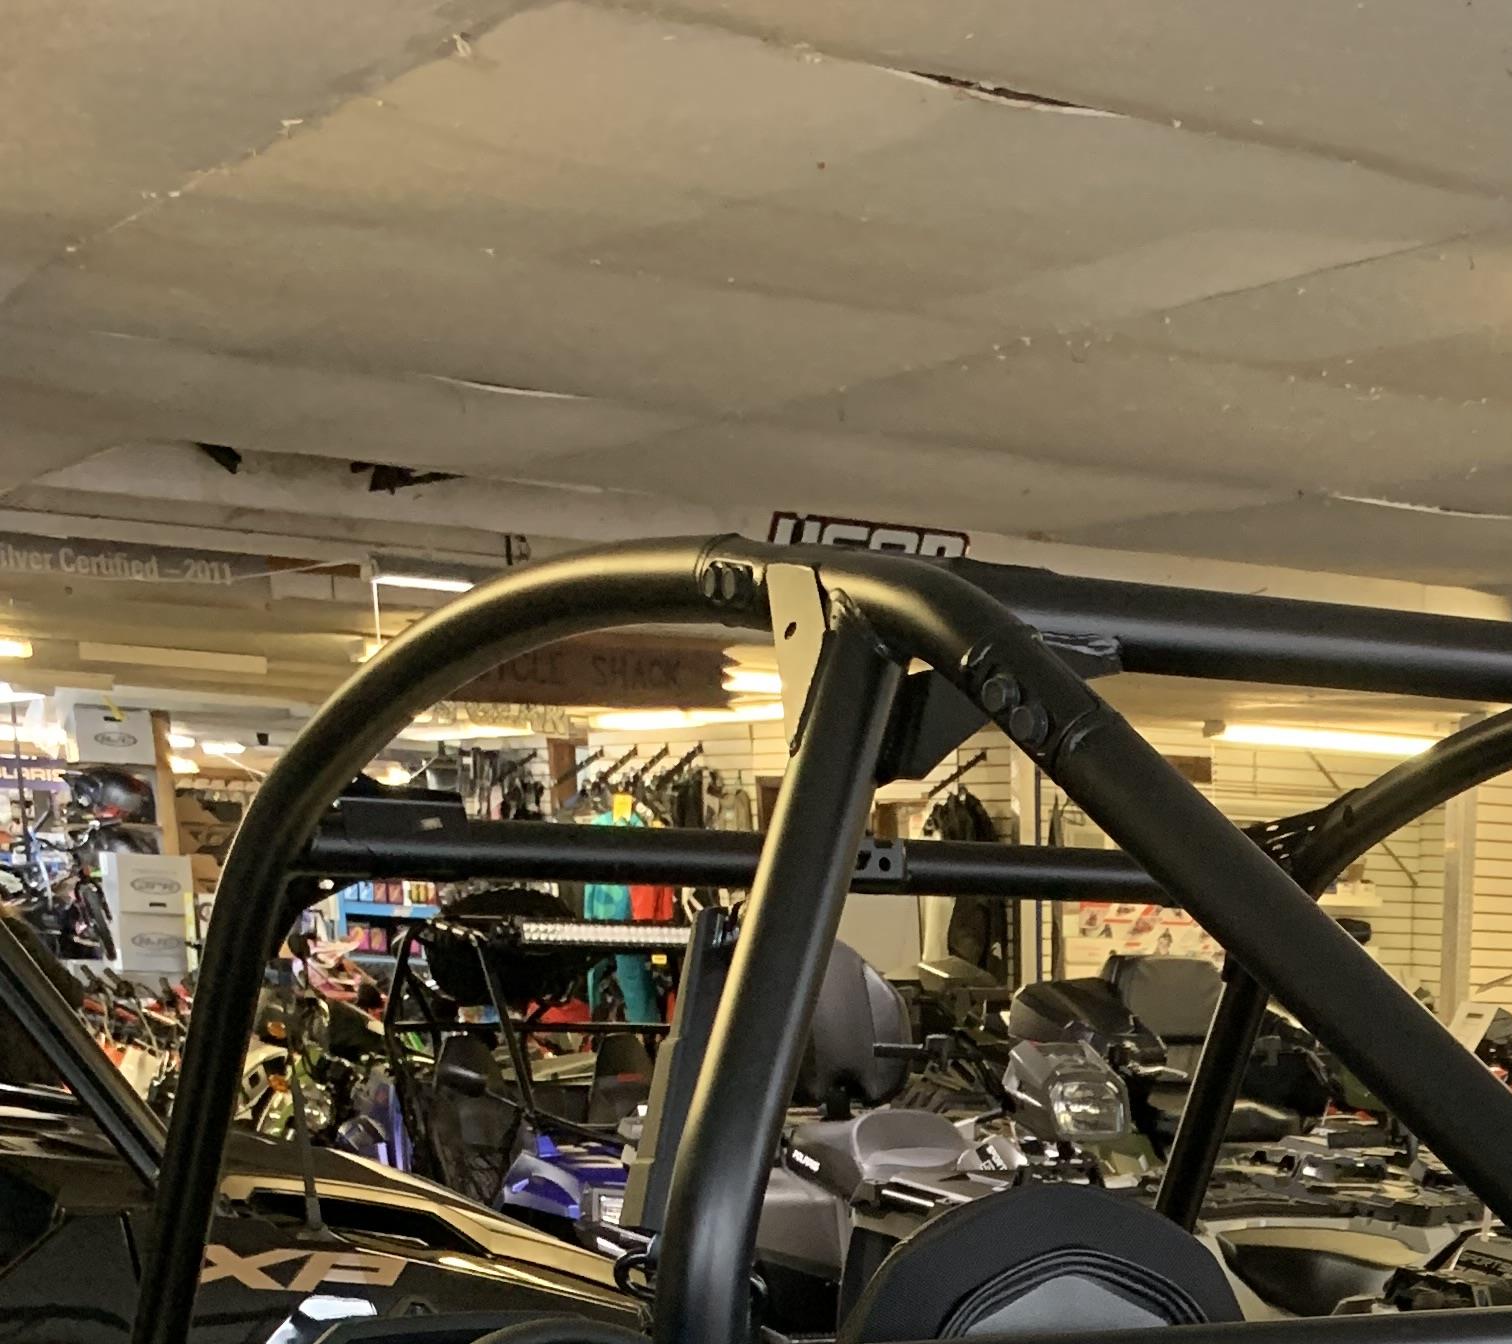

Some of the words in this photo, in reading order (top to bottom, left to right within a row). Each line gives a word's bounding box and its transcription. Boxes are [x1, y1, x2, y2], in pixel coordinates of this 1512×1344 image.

[0, 542, 52, 571] ilver
[58, 547, 158, 580] Certified
[199, 1243, 408, 1292] XP
